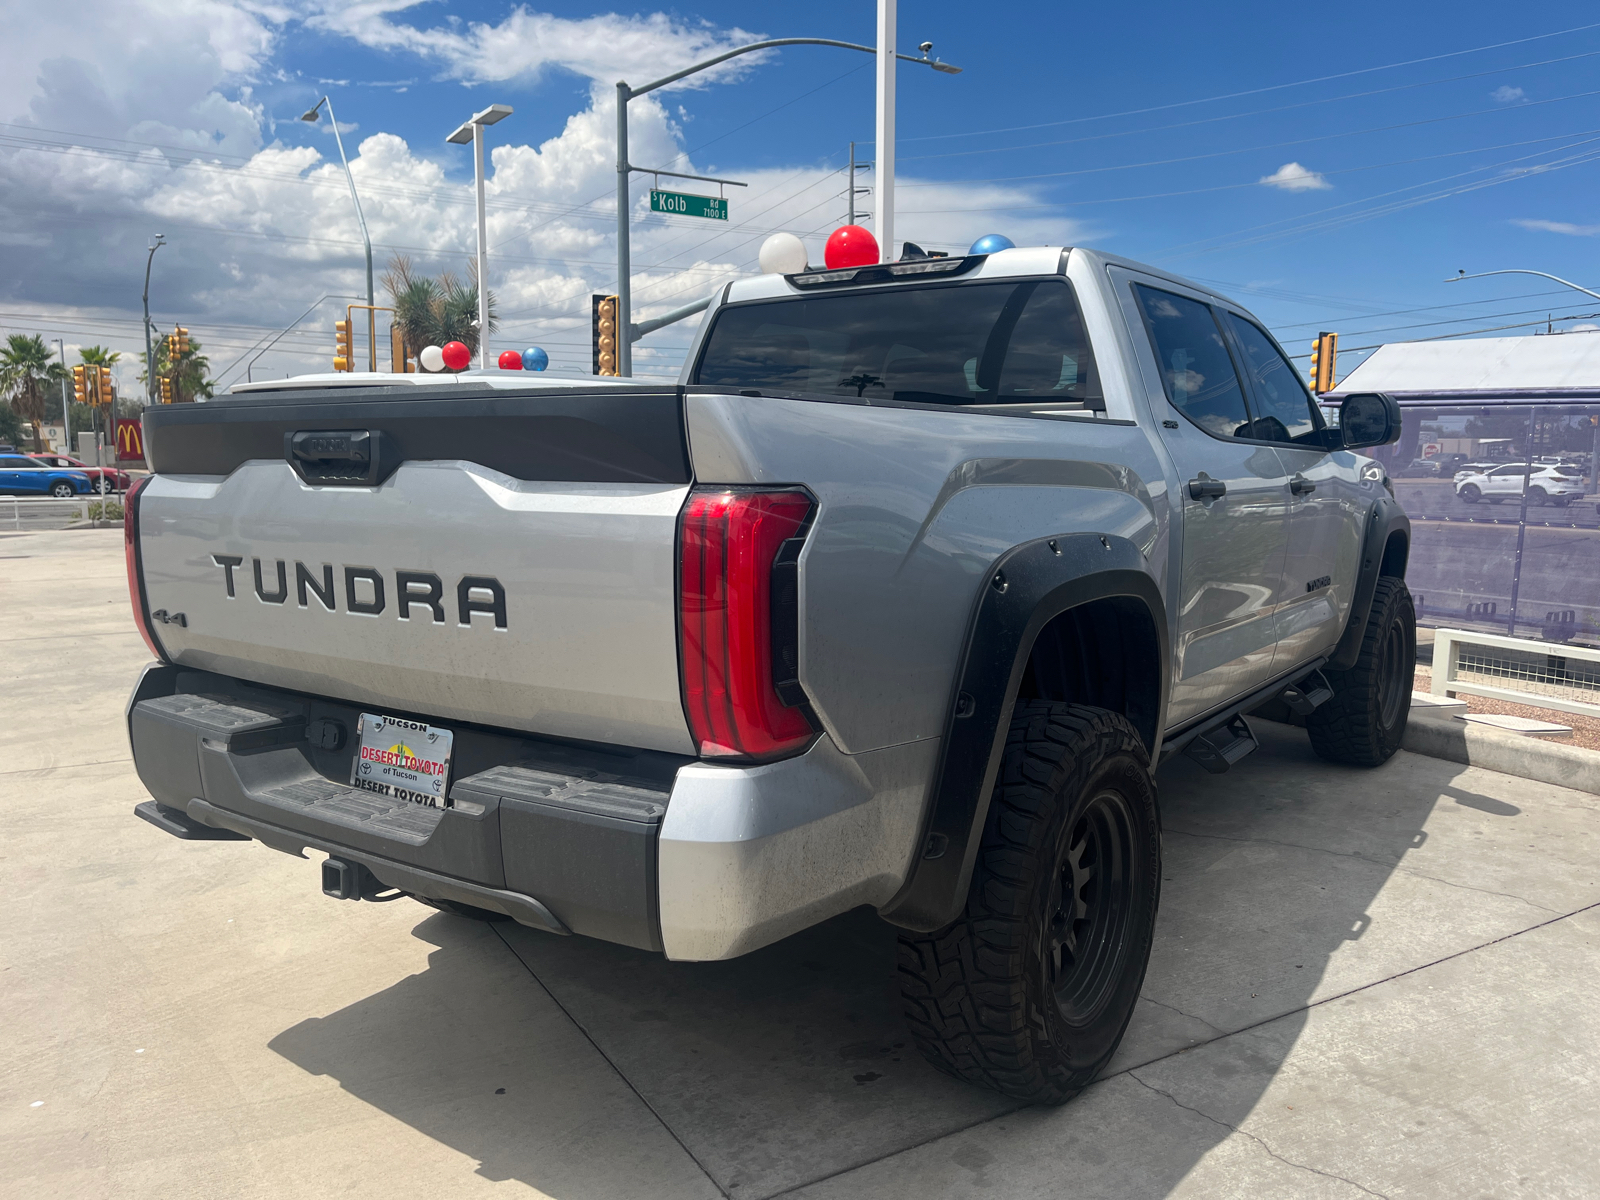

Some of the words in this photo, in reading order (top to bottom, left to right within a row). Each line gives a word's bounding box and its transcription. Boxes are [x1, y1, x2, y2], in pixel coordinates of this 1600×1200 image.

[660, 194, 686, 211] Kolb
[710, 199, 718, 208] Rd
[703, 208, 719, 218] 7100
[210, 554, 507, 632] TUNDRA
[382, 716, 427, 732] TUCSON
[361, 746, 401, 766] DESERT
[404, 756, 444, 776] TOYOTA
[383, 767, 391, 776] of
[392, 768, 418, 781] Tucson
[354, 778, 391, 796] DESERT
[394, 788, 437, 808] TOYOTA
[1124, 762, 1153, 810] OPEN
